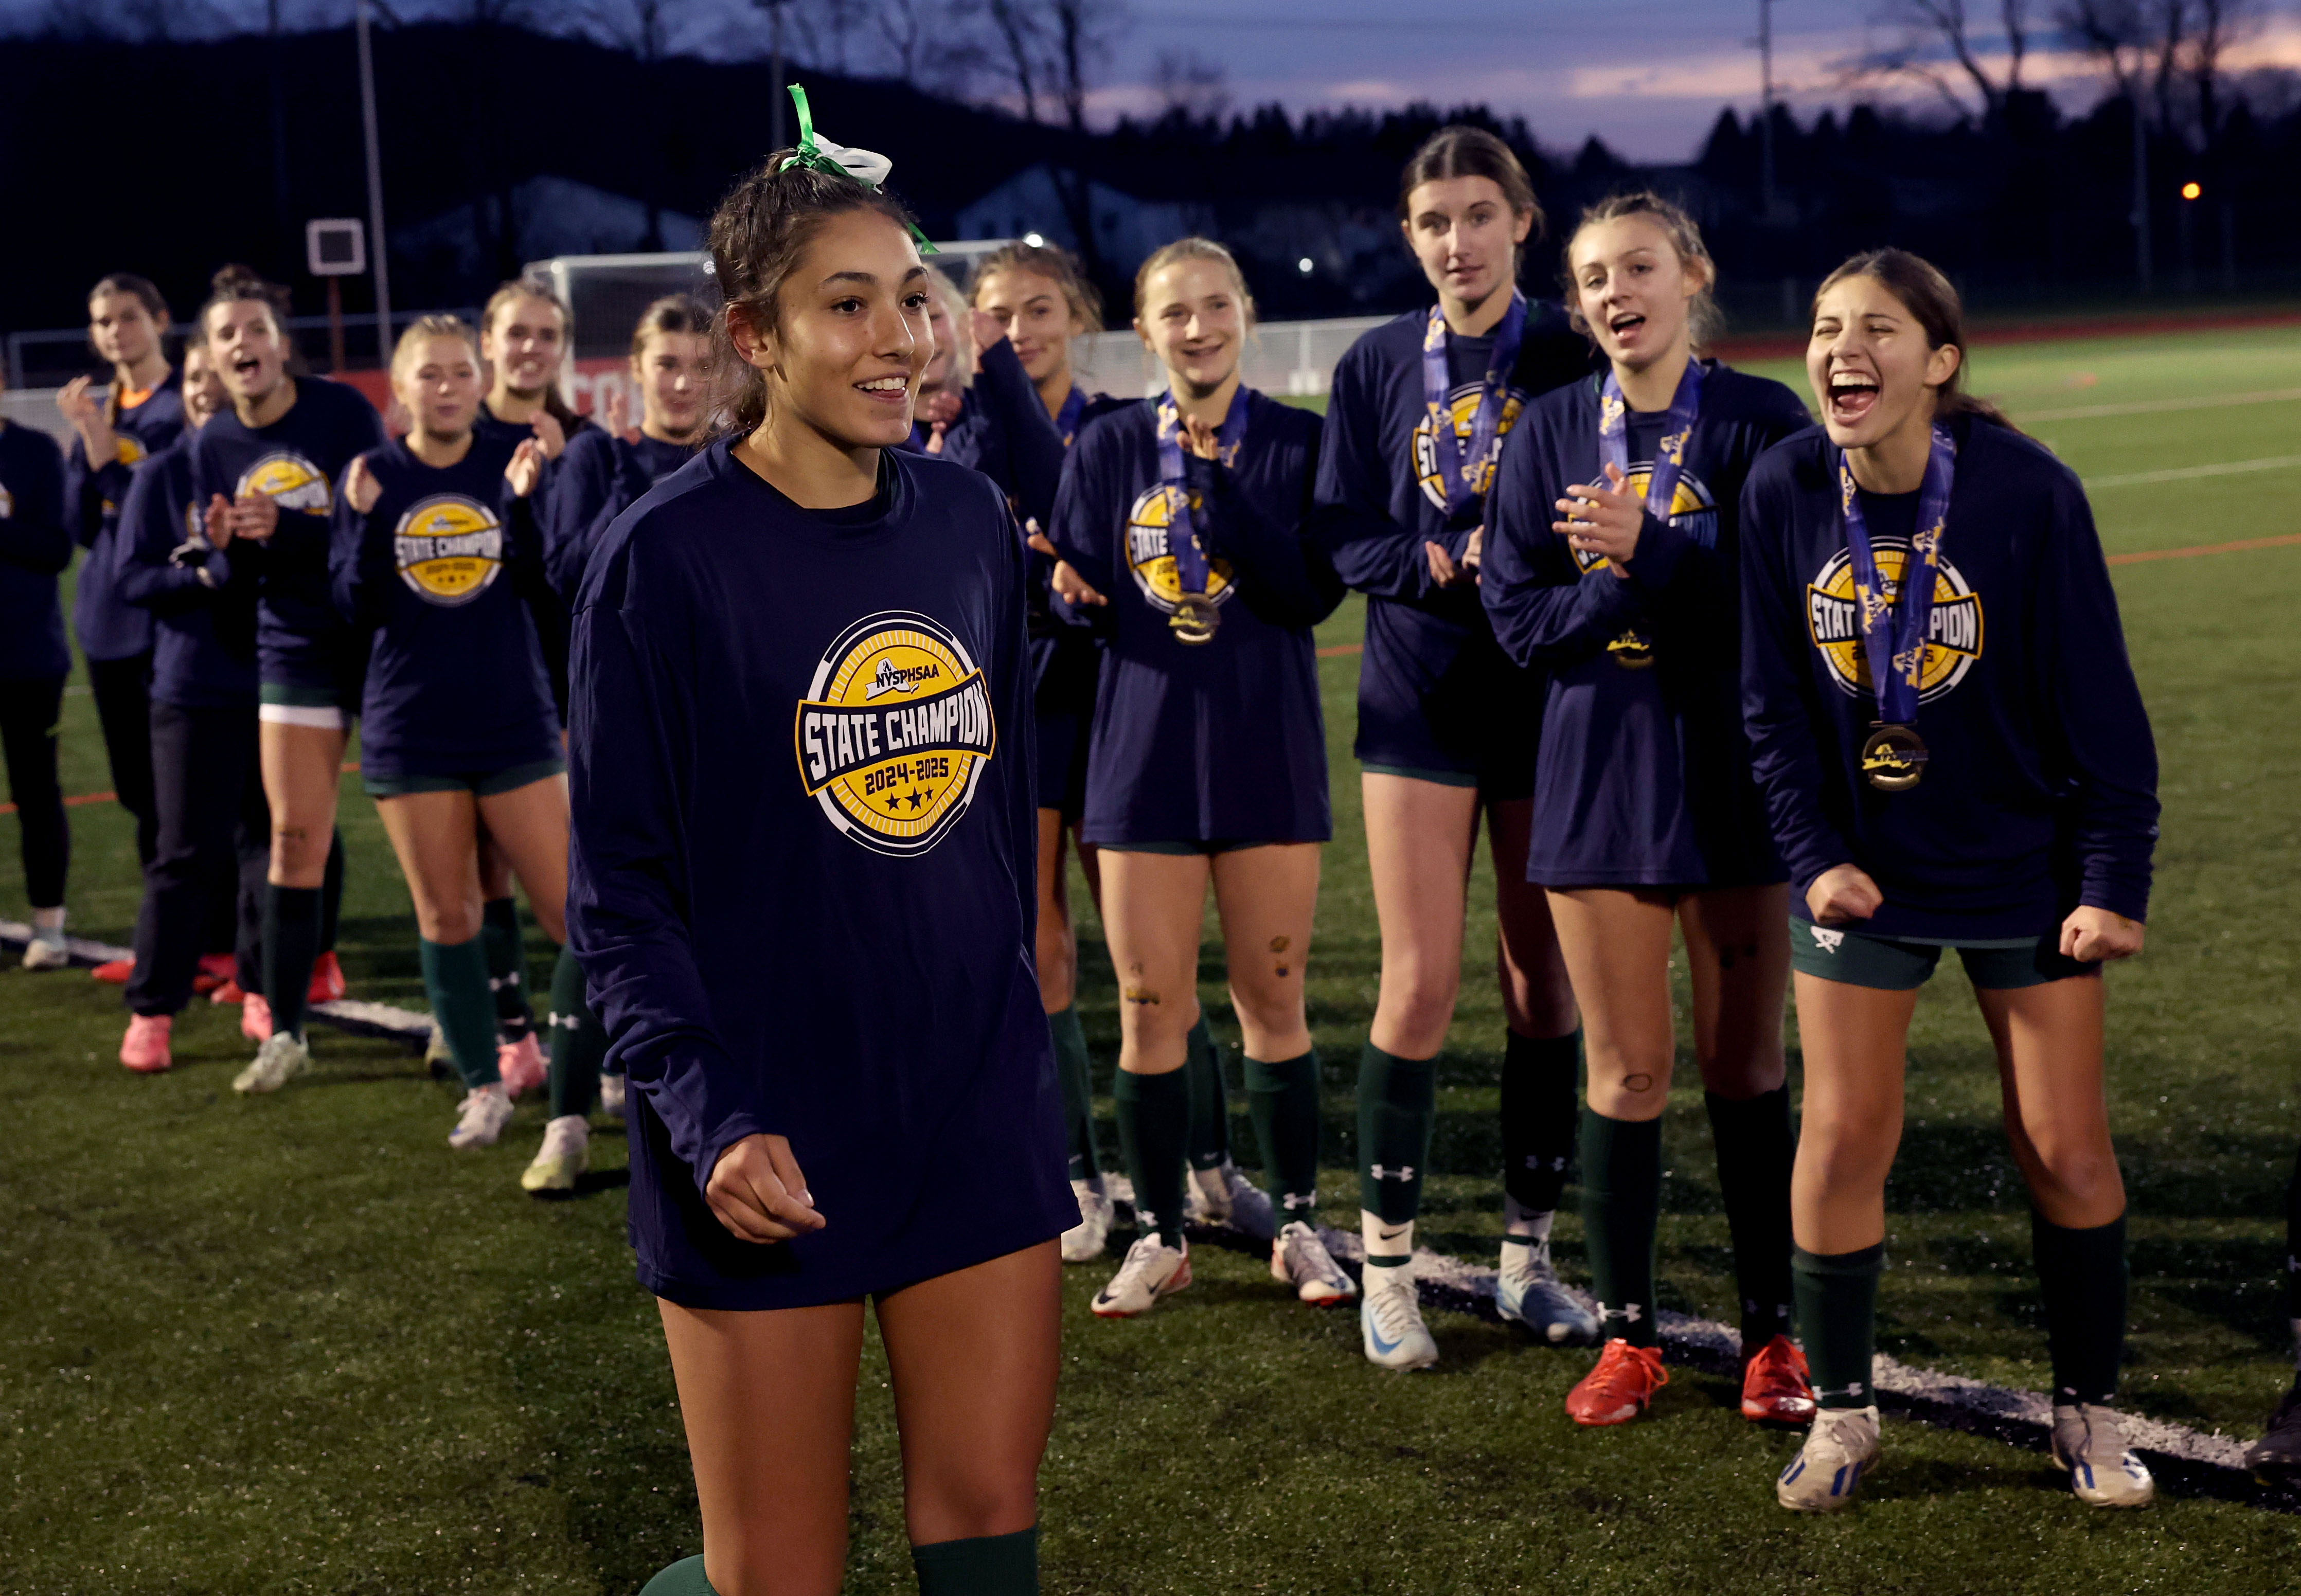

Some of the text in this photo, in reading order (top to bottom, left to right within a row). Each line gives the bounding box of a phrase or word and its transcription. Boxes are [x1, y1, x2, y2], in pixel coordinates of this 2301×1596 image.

[1812, 593, 1856, 639] STAT
[1930, 601, 1976, 650] PION
[876, 663, 939, 688] NYSPHSAA
[805, 680, 988, 781] STATE CHAMPION
[865, 758, 949, 796] 2024-2025
